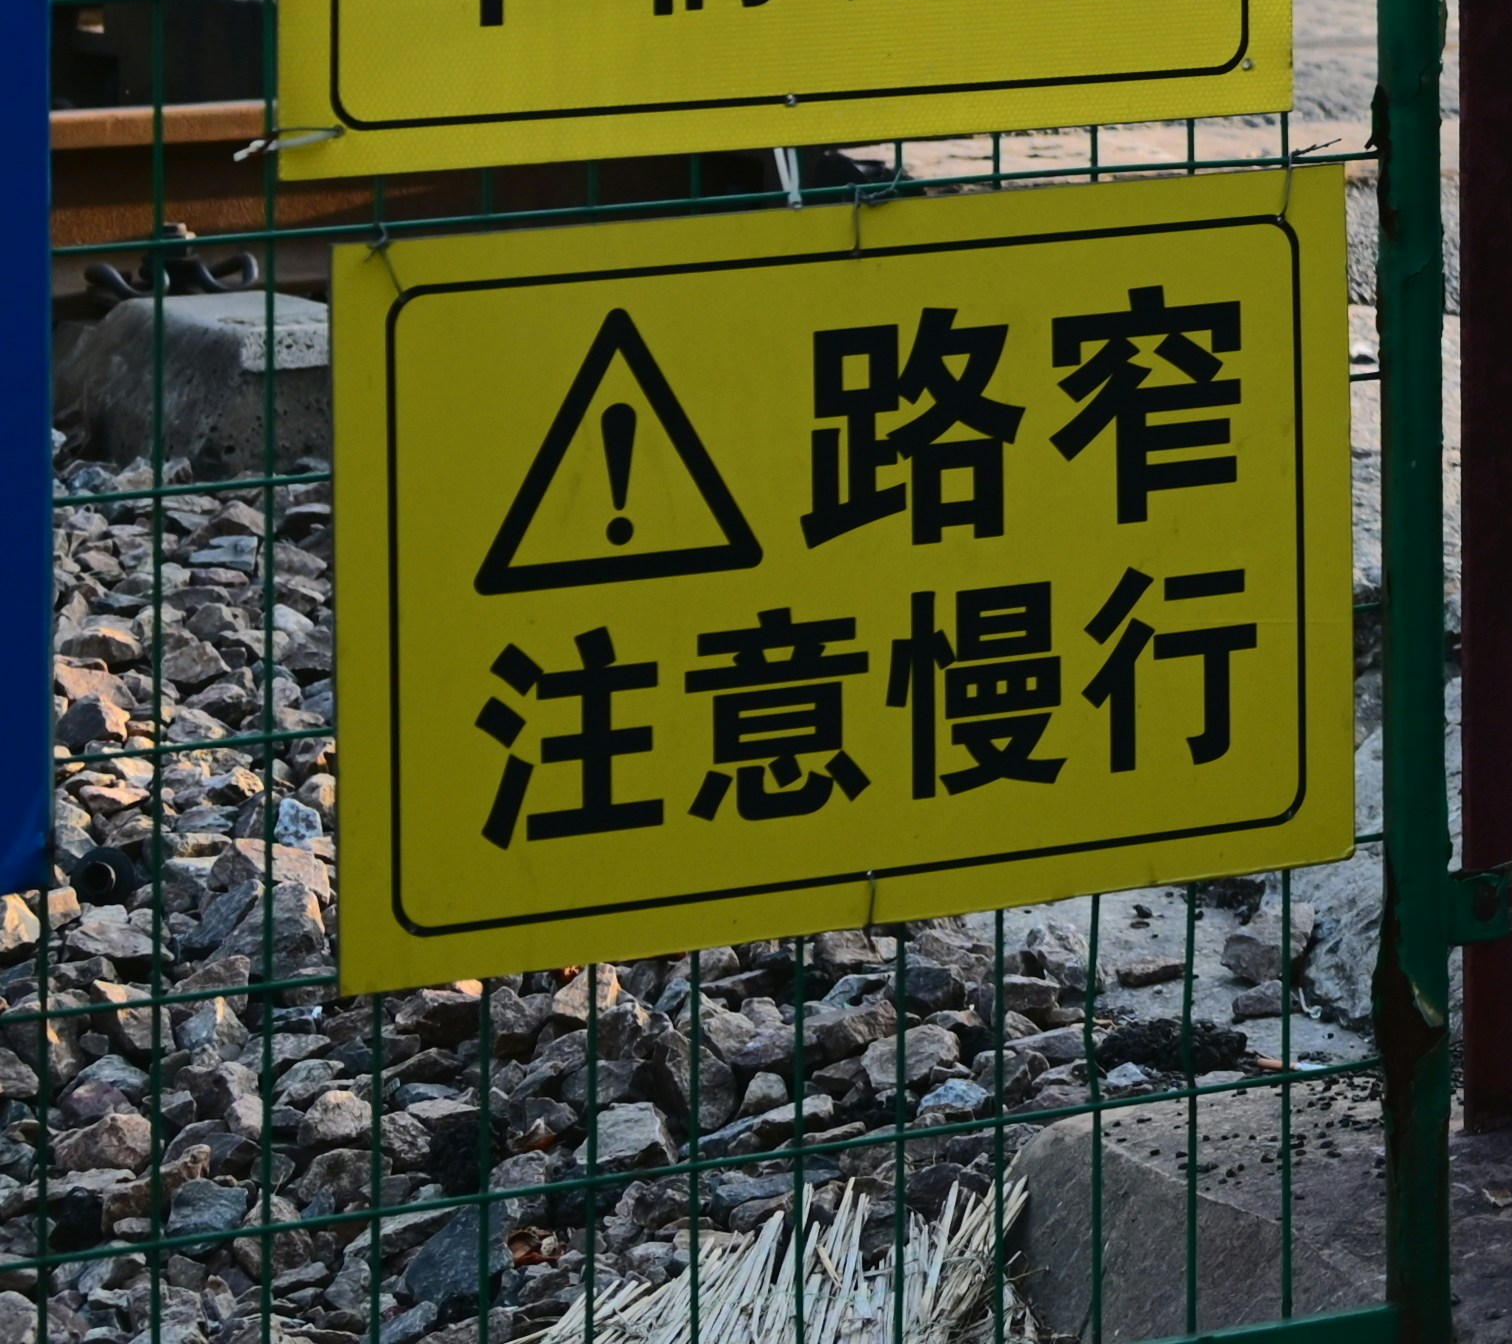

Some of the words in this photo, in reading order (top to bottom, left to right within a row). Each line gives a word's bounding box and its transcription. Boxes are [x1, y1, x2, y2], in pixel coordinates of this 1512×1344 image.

[800, 285, 1241, 549] 路窄
[474, 567, 1258, 850] 注意慢行
